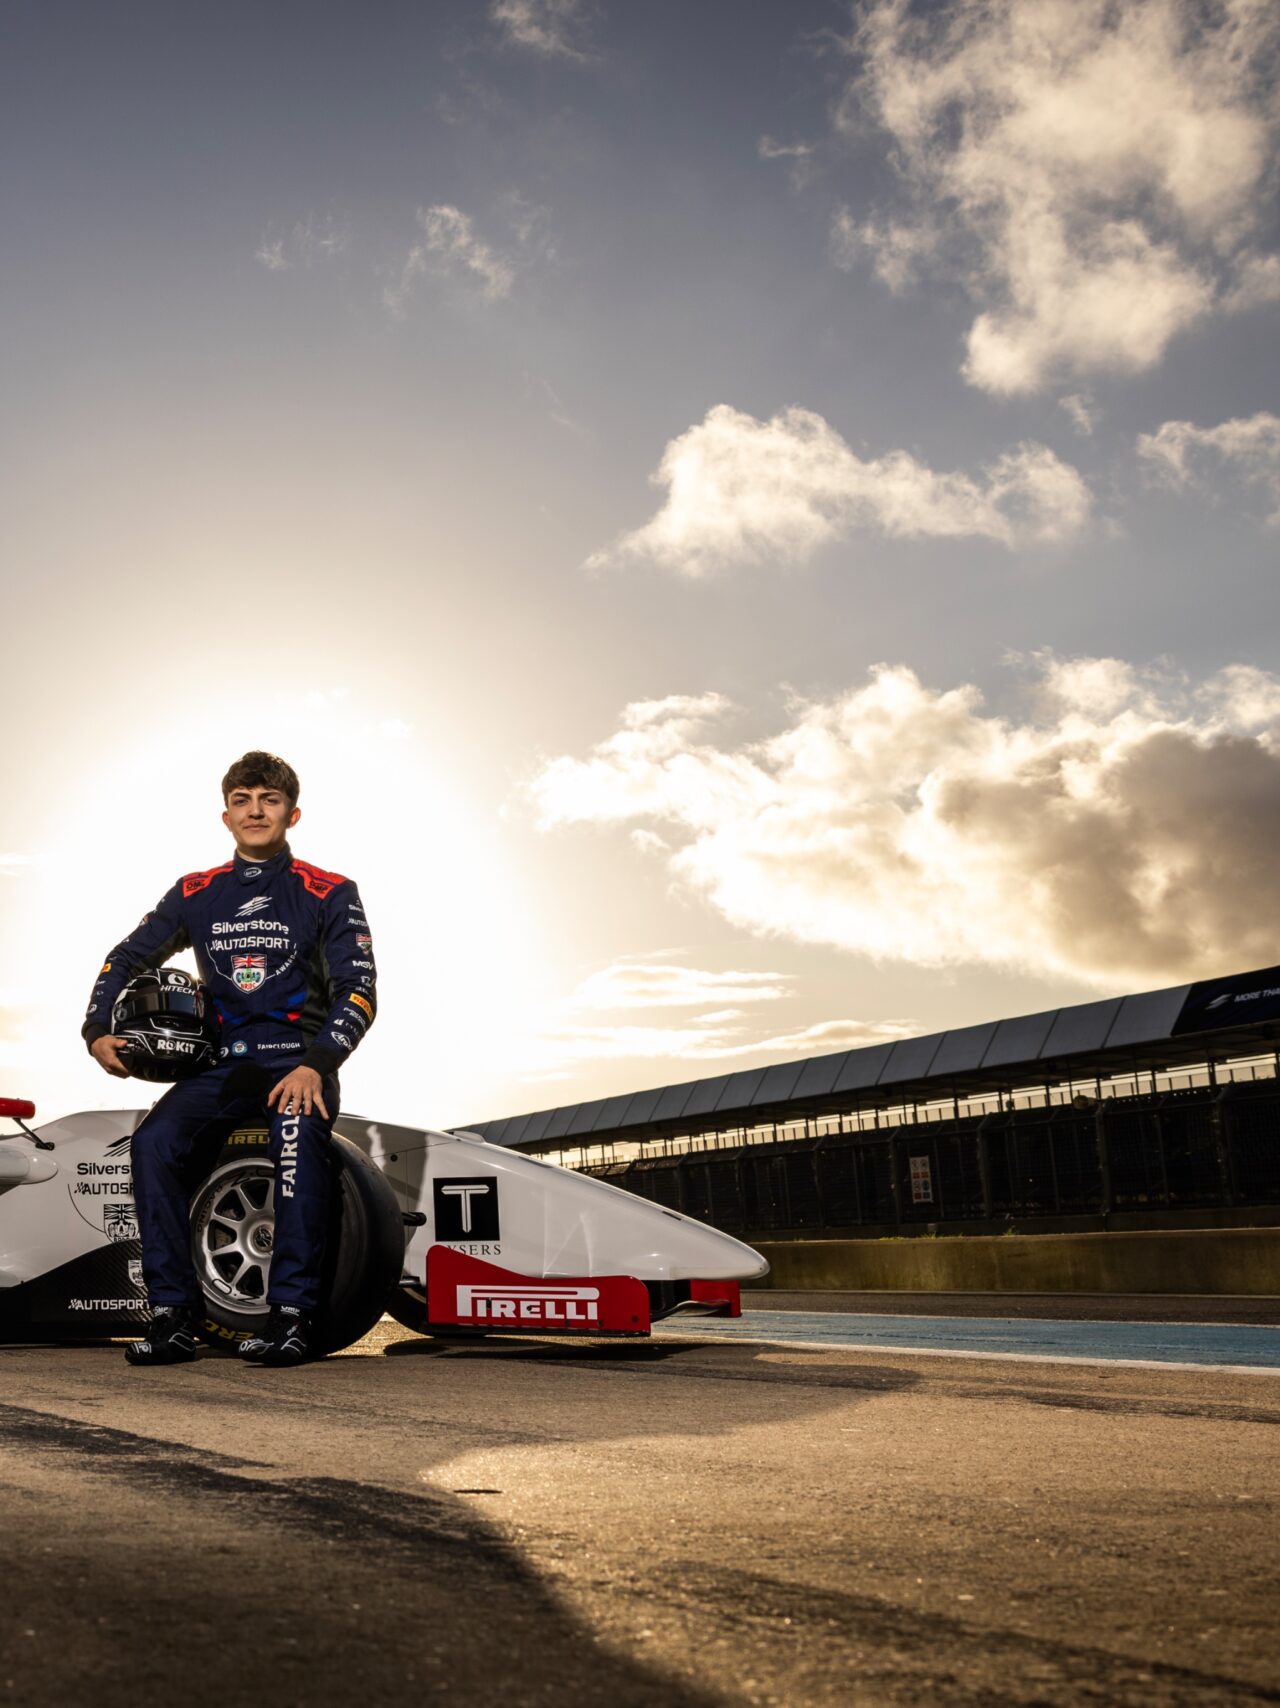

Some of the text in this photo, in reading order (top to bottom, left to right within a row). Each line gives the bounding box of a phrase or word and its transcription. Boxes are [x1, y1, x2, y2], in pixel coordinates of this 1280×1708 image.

[211, 919, 289, 935] Silverstone
[215, 936, 290, 951] AUTOSPORT
[352, 960, 373, 970] MSV
[160, 985, 196, 996] HITECH
[1234, 991, 1260, 1002] MORE
[77, 1162, 131, 1175] Silvers
[456, 1284, 600, 1320] PIRELLI
